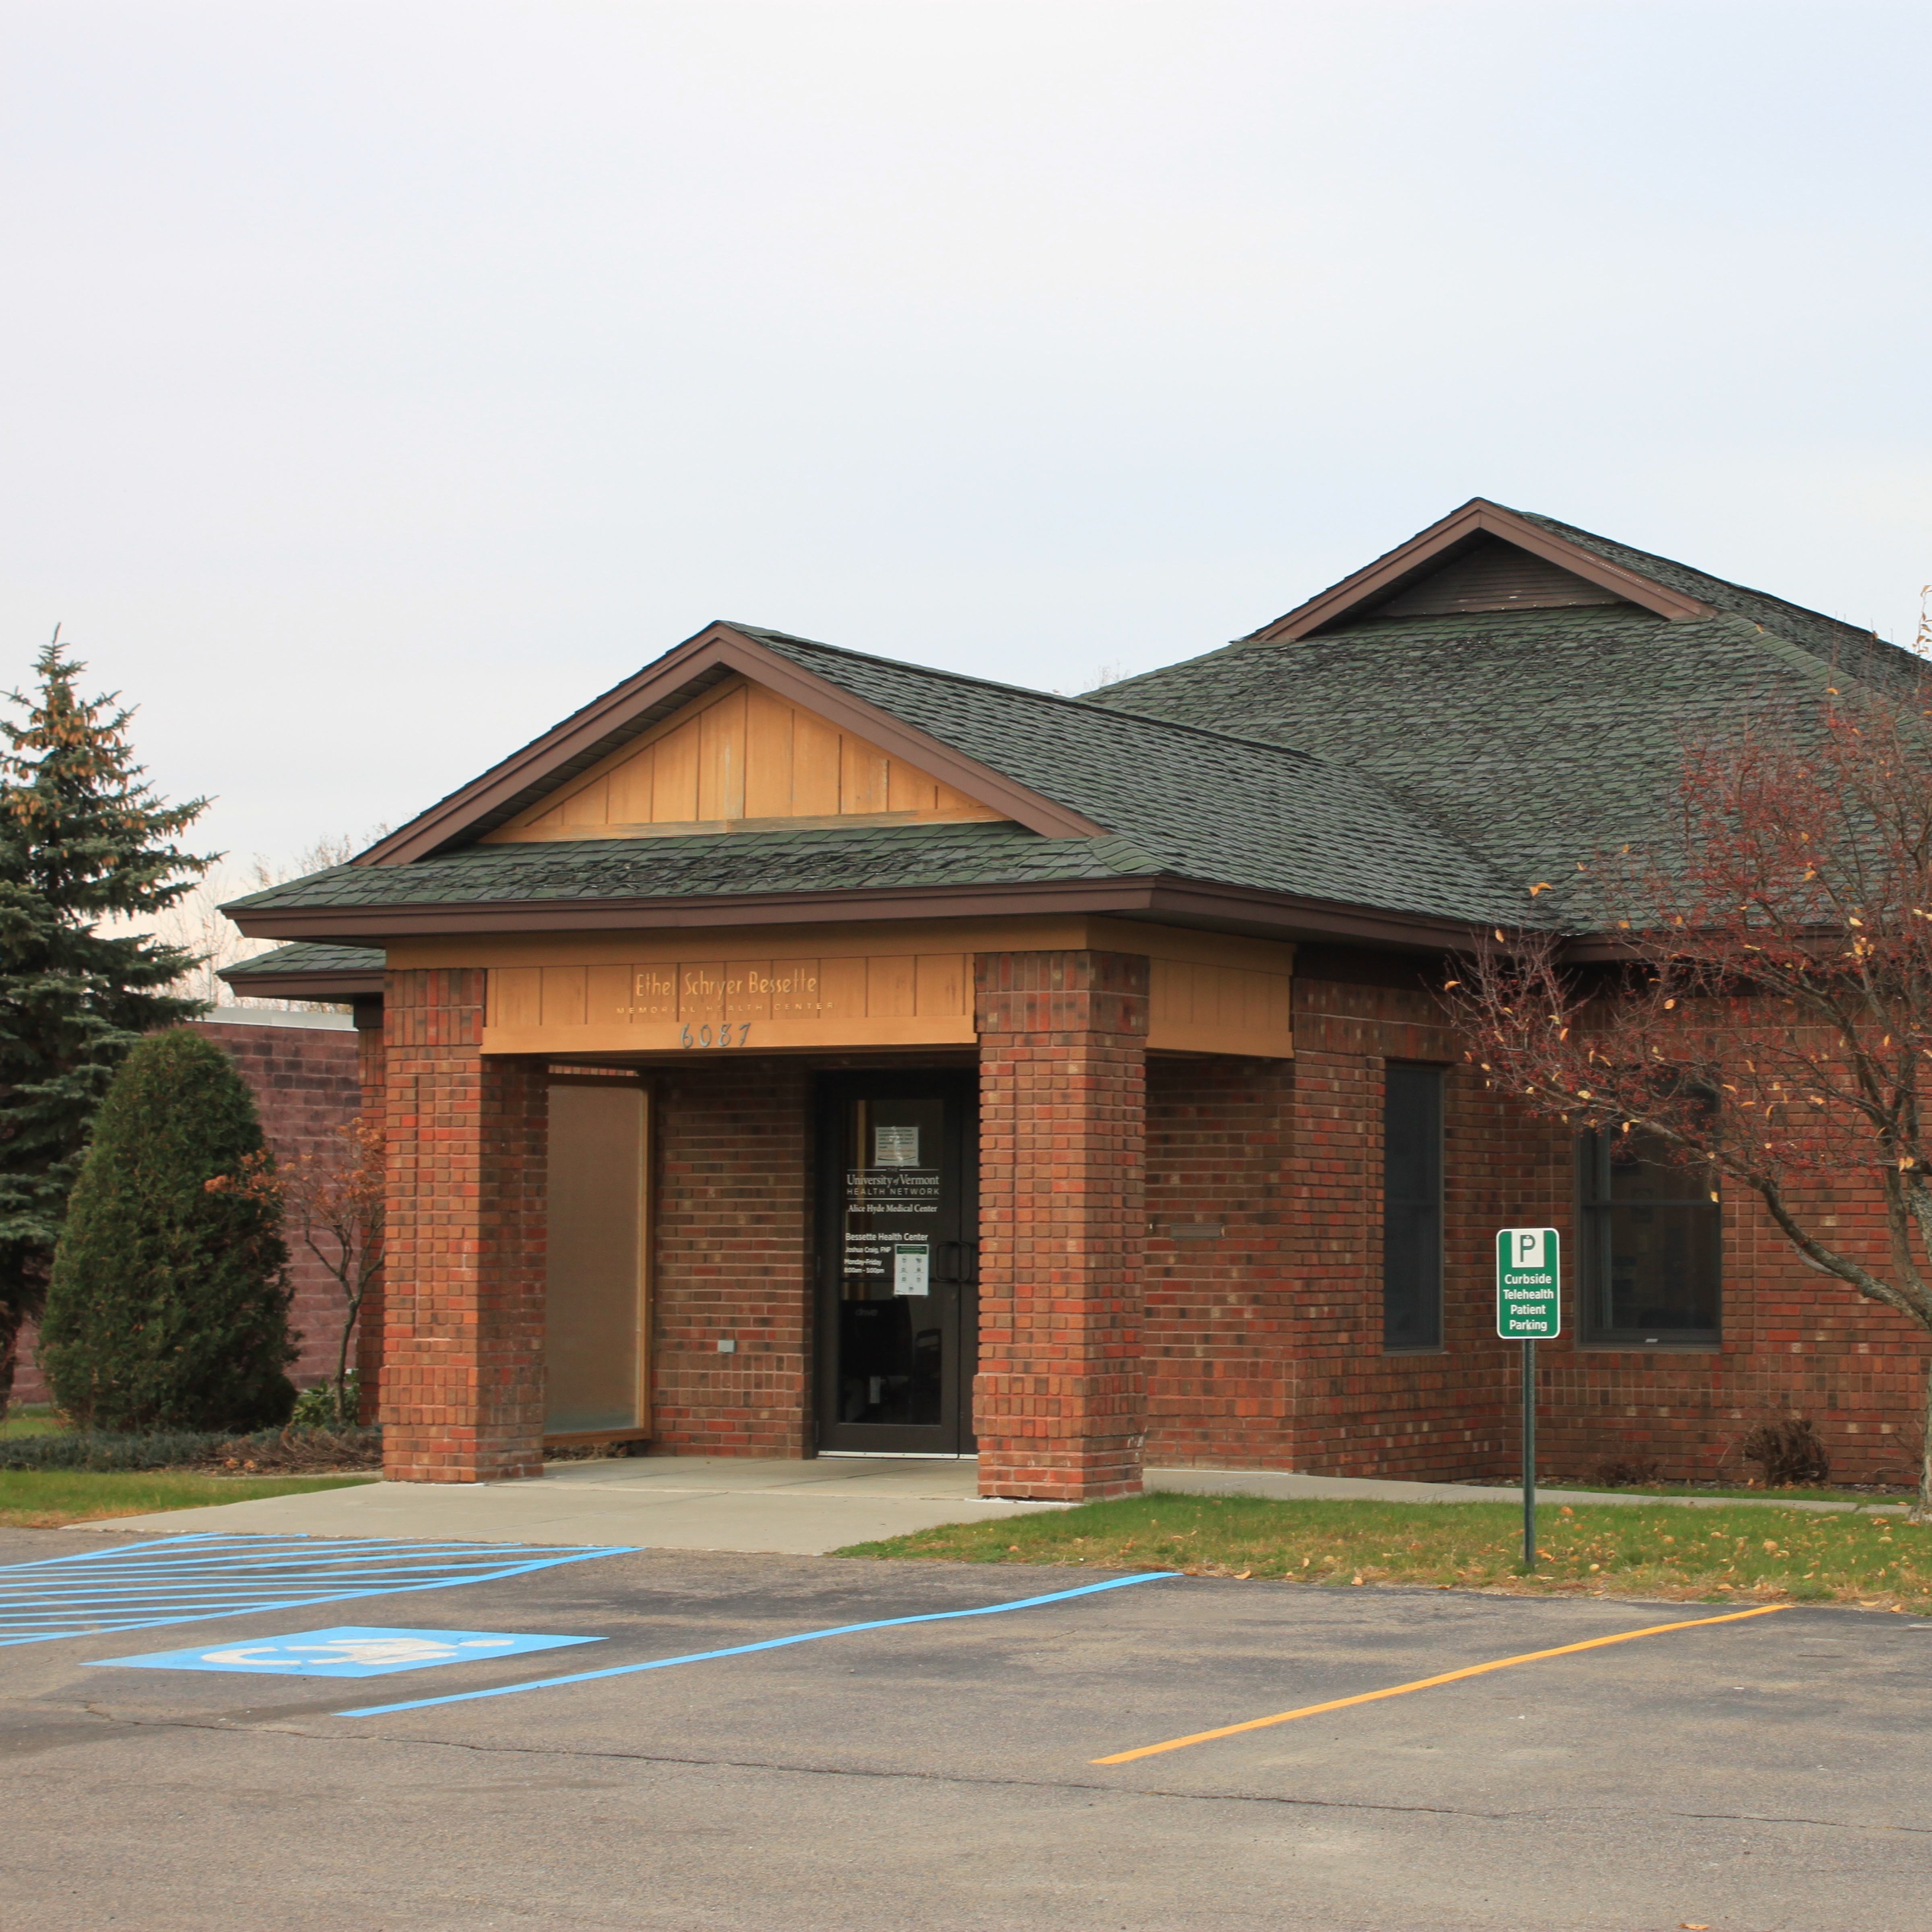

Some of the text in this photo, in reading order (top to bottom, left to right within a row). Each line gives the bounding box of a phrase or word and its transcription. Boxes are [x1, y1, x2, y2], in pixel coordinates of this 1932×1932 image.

[635, 968, 817, 1001] Ethel Schryer Bessette
[774, 1002, 834, 1010] CENTER
[680, 1022, 751, 1049] 6087
[846, 1174, 939, 1188] University of Vermont
[848, 1204, 865, 1212] Alice
[867, 1204, 884, 1214] Hyde
[886, 1204, 913, 1212] Medical
[1519, 1234, 1536, 1263] P
[1504, 1274, 1552, 1284] Curbside
[1503, 1289, 1554, 1300] Telehealth
[1510, 1304, 1546, 1315] Patient
[1509, 1319, 1548, 1332] Parking
